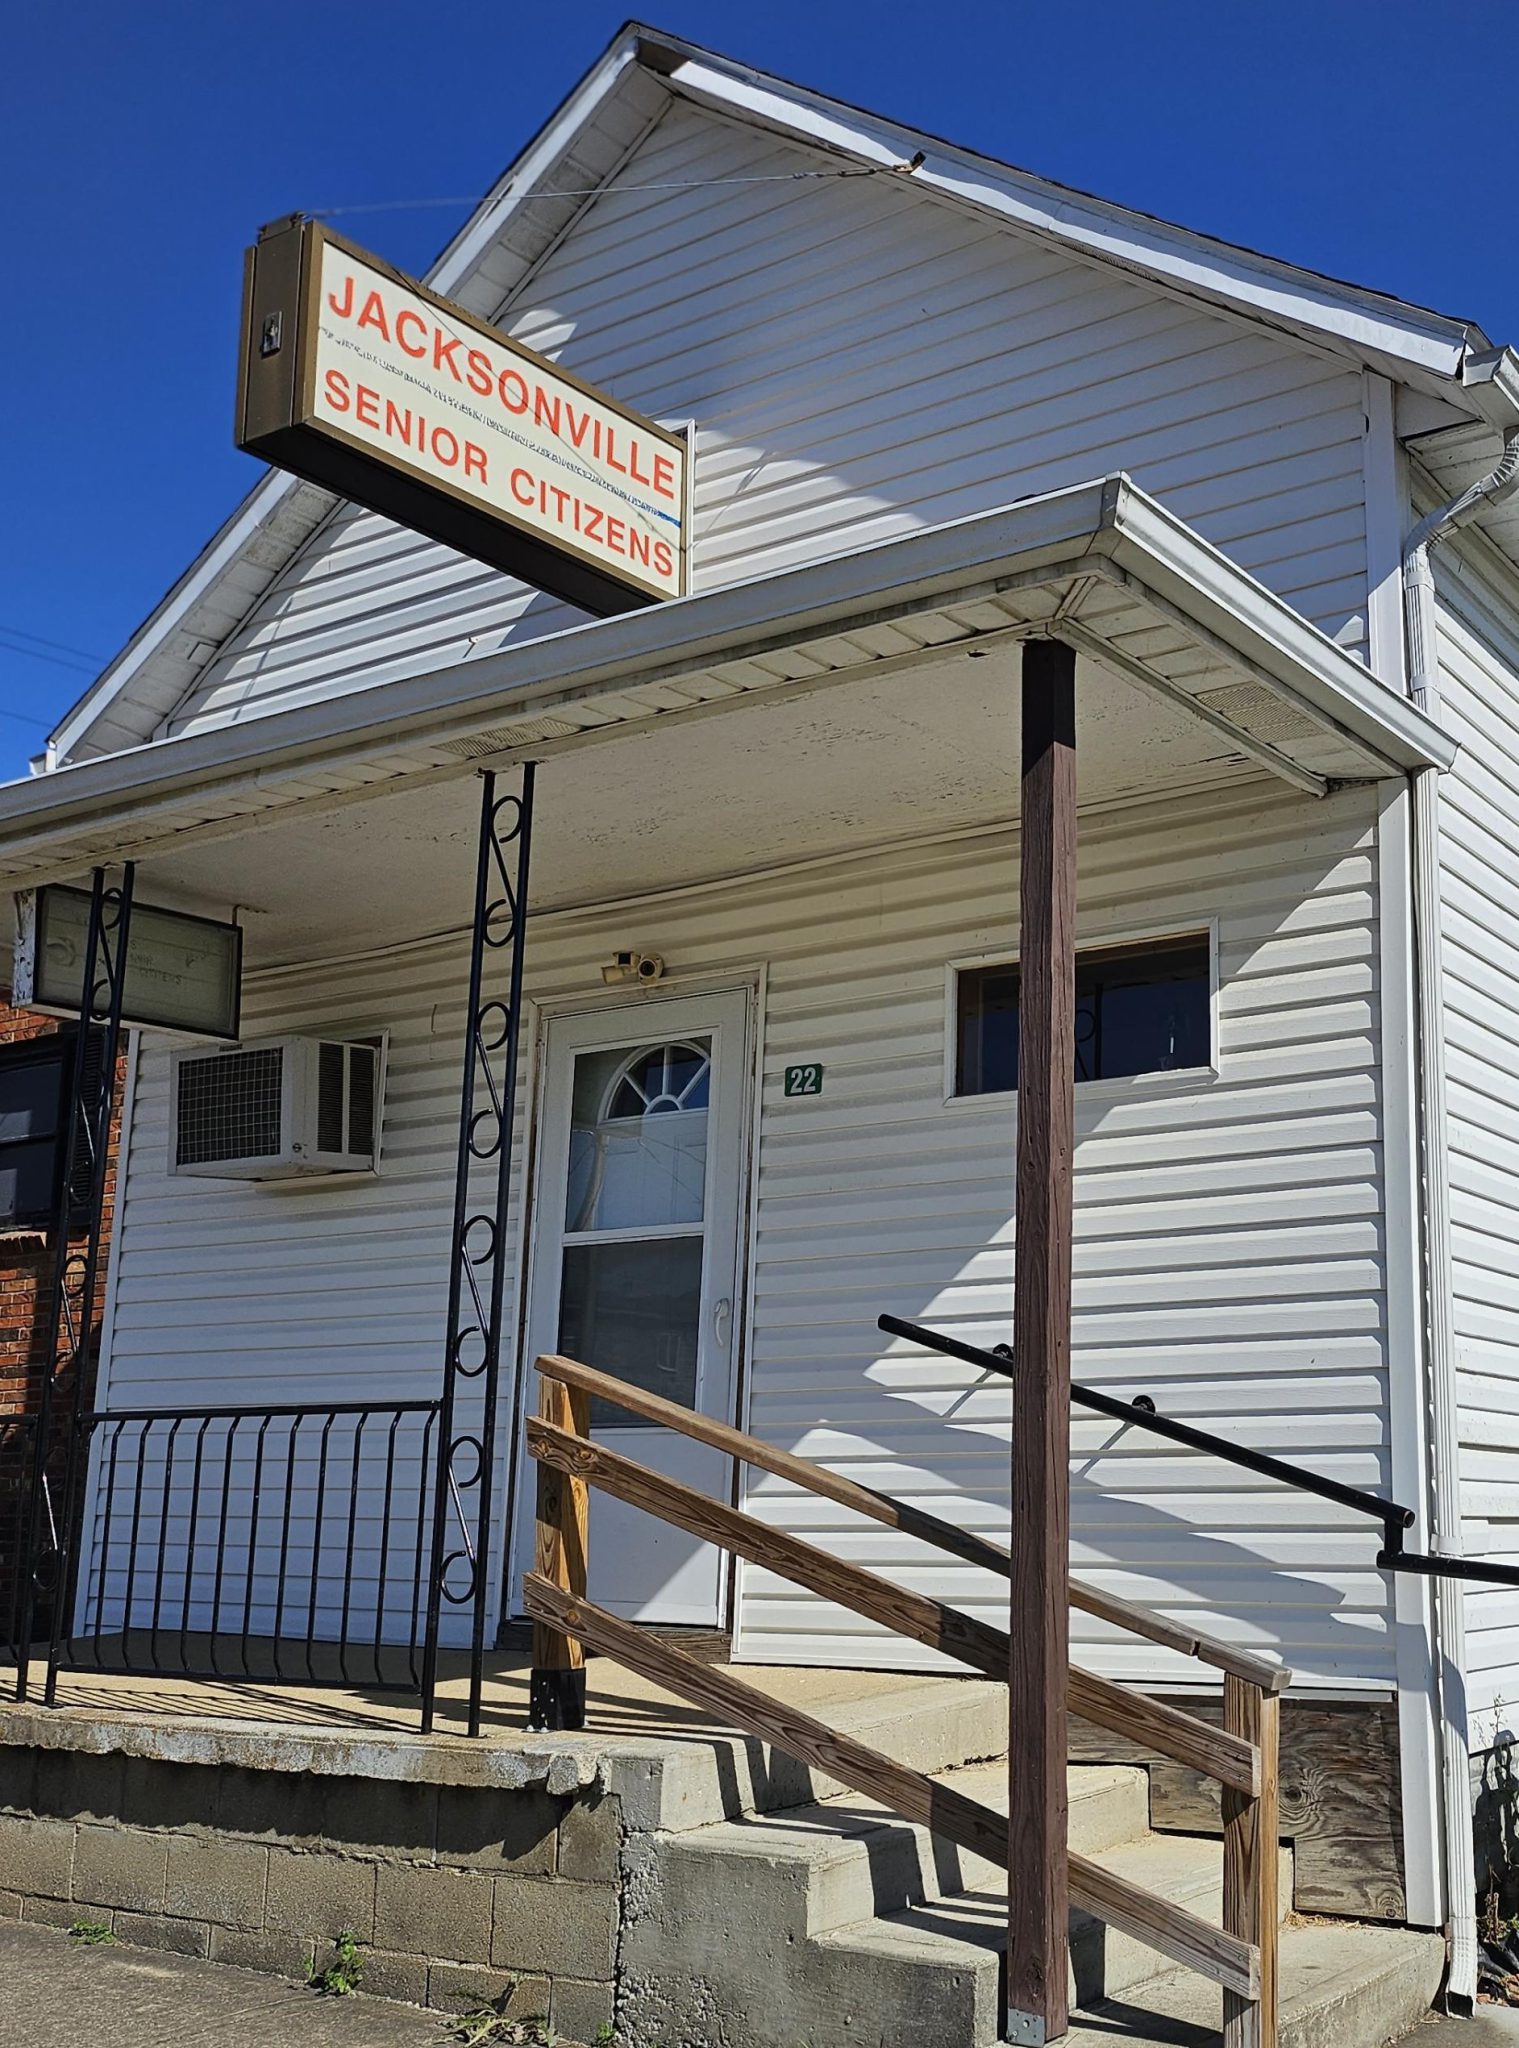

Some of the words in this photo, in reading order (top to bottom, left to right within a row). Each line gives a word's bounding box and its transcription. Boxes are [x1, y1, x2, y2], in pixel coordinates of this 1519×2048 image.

[324, 369, 489, 485] SENIOR
[510, 468, 674, 577] CITIZENS
[328, 276, 675, 499] JACKSONVILLE
[790, 1067, 816, 1093] 22
